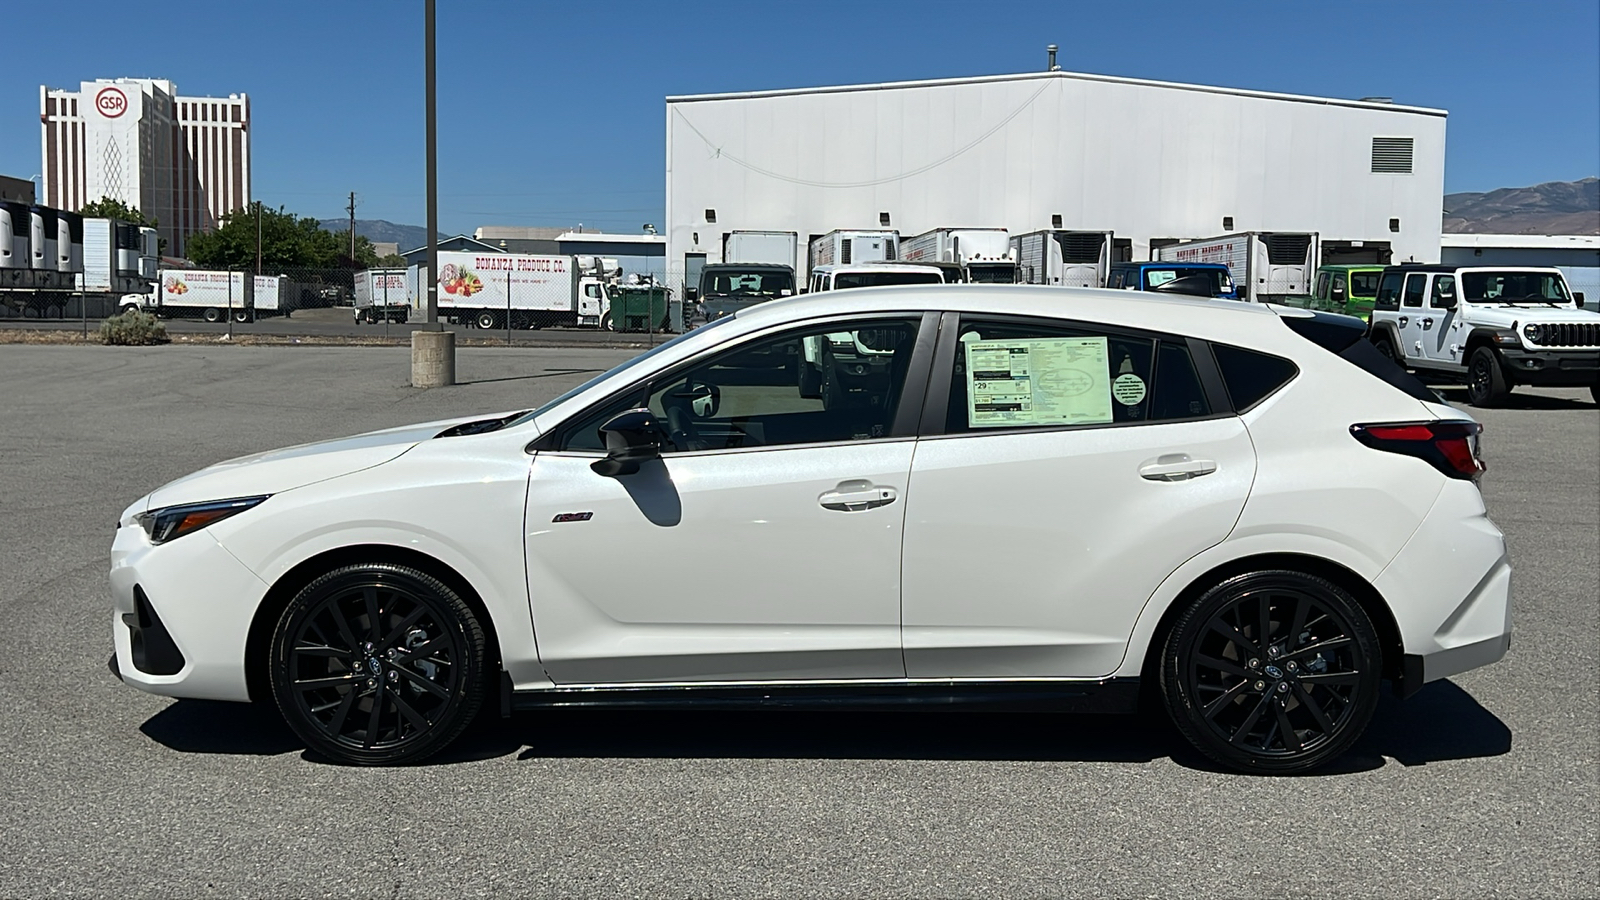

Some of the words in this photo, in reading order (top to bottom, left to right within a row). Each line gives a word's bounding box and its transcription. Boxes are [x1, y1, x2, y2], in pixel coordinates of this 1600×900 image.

[100, 96, 123, 110] GSR
[475, 257, 513, 271] BONANZA
[517, 258, 550, 272] PRODUCE
[553, 260, 566, 273] CO.
